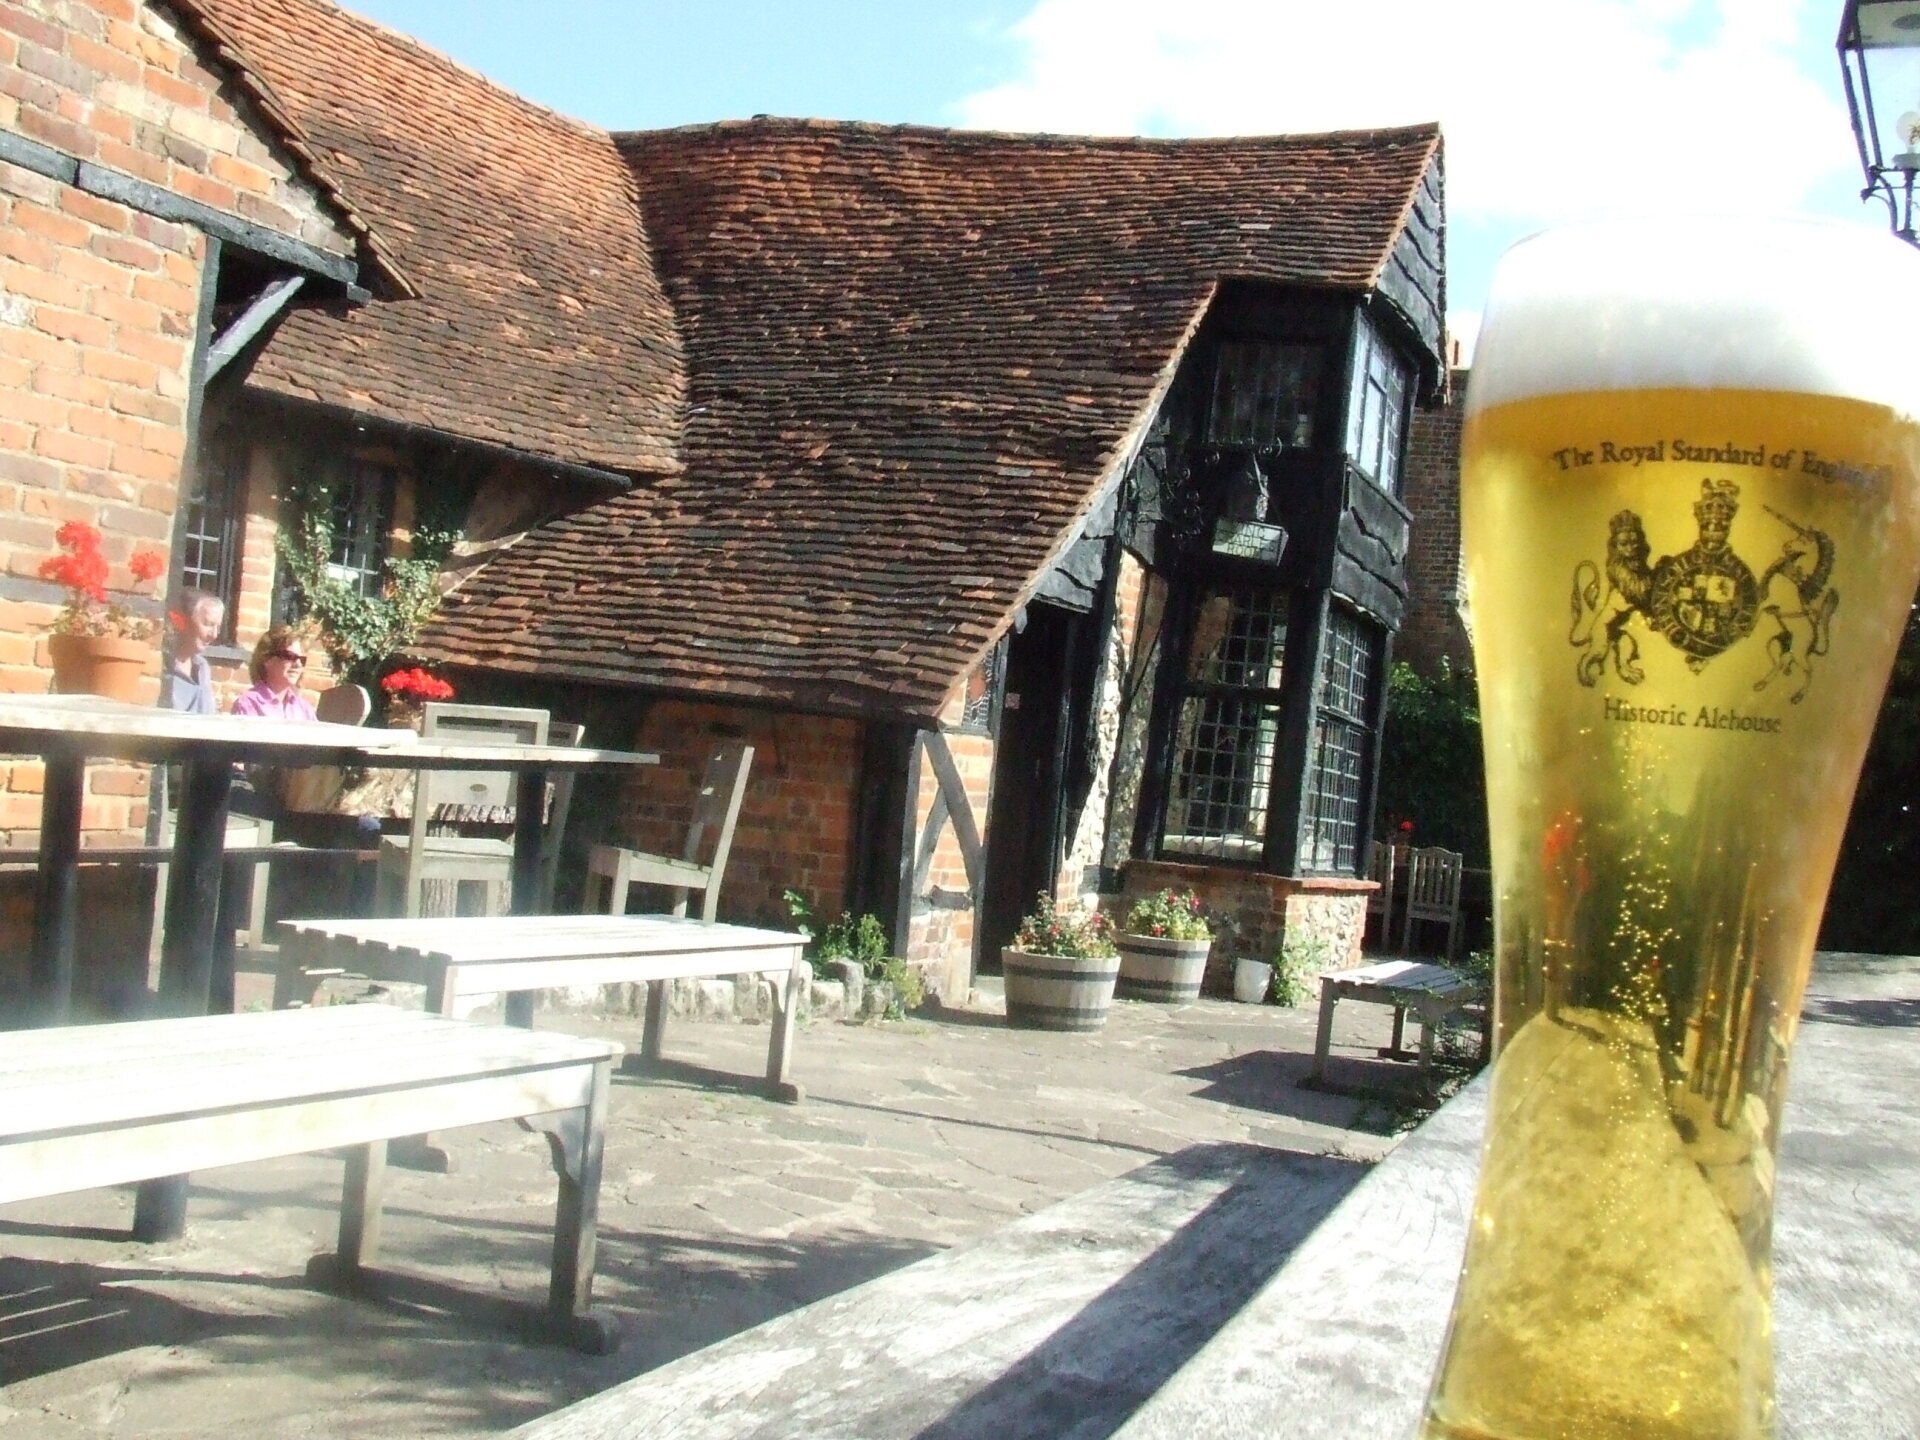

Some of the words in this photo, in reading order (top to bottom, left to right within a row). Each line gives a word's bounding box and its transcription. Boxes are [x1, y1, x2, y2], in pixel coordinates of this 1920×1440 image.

[1554, 448, 1594, 470] The
[1600, 441, 1665, 467] Royal
[1671, 440, 1765, 466] Standard
[1771, 449, 1796, 469] of
[1802, 450, 1874, 488] Englan
[1603, 697, 1687, 727] Historic
[1693, 705, 1783, 733] Alehouse
